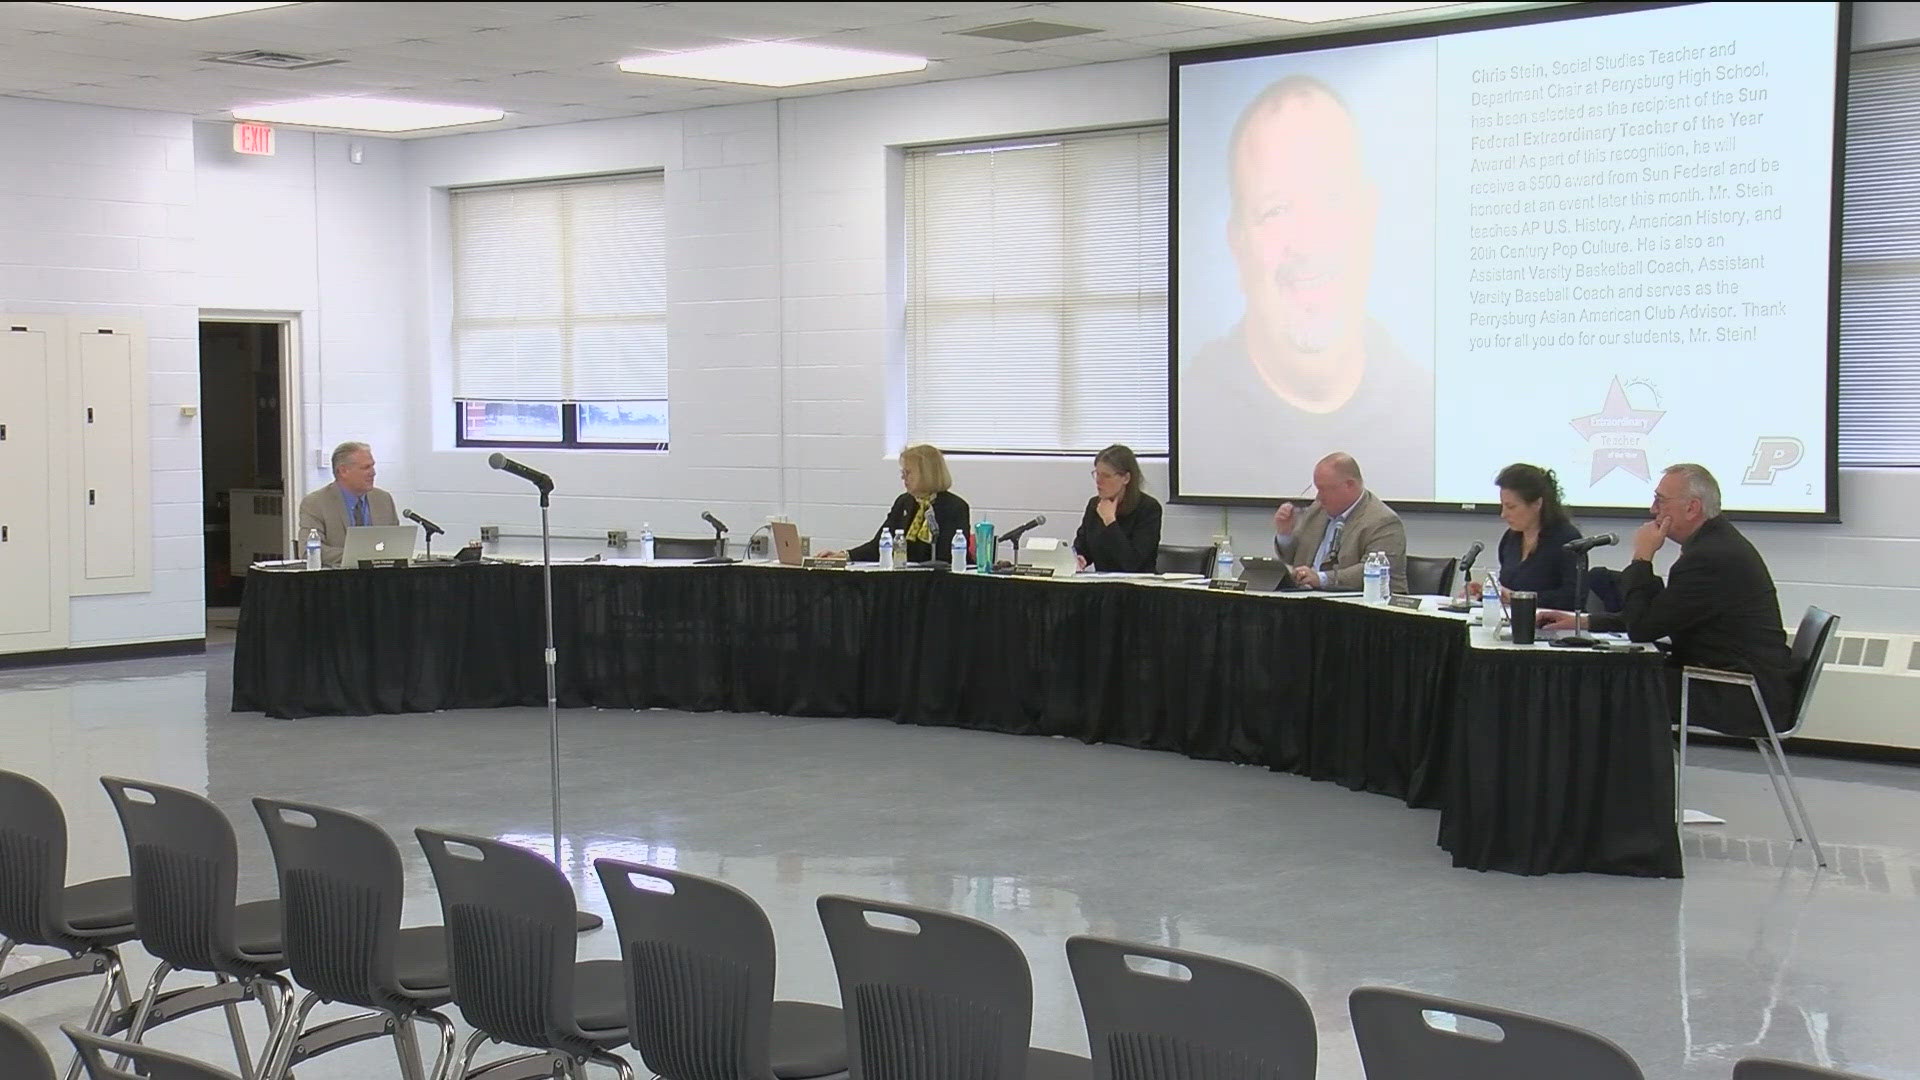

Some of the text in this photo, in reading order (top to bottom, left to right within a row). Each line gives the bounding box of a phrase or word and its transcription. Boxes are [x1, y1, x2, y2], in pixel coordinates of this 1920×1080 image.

[1472, 67, 1506, 83] Chris
[1552, 58, 1591, 76] Social
[1596, 53, 1644, 70] Studies
[1650, 47, 1705, 65] Teacher
[1709, 41, 1736, 58] and
[1472, 89, 1544, 108] Department
[1548, 83, 1582, 99] Chair
[1586, 82, 1598, 95] at
[1602, 73, 1674, 95] Perrysburg
[1678, 68, 1711, 86] High
[1471, 88, 1768, 128] has been selected as the recipient of the Sun
[241, 126, 271, 153] EXIT
[1471, 111, 1764, 150] Federal Extraordinary Teacher of the Year
[1519, 155, 1535, 168] As
[1540, 151, 1564, 169] part
[1568, 149, 1580, 164] of
[1584, 148, 1606, 163] this
[1693, 139, 1710, 154] he
[1714, 136, 1736, 153] will
[1470, 159, 1780, 194] receive a $500 award from Sun Federal and be
[1471, 202, 1520, 217] honored
[1524, 201, 1536, 213] at
[1540, 200, 1555, 212] an
[1559, 195, 1594, 211] event
[1598, 193, 1627, 209] later
[1631, 191, 1655, 206] this
[1736, 182, 1773, 198] Stein
[1470, 225, 1517, 239] teaches
[1522, 222, 1540, 236] AP
[1629, 213, 1692, 230] American
[1755, 205, 1782, 221] and
[1470, 246, 1496, 260] 20th
[1500, 242, 1548, 261] Century
[1552, 242, 1577, 259] Pop
[1637, 238, 1655, 251] He
[1660, 237, 1670, 250] is
[1675, 235, 1702, 249] also
[1707, 234, 1724, 247] an
[1470, 268, 1525, 283] Assistant
[1529, 264, 1572, 283] Varsity
[1576, 259, 1643, 278] Basketball
[1699, 254, 1765, 271] Assistant
[1470, 279, 1738, 306] Varsity Baseball Coach and serves as the
[1470, 310, 1536, 329] Perrysburg
[1540, 309, 1575, 325] Asian
[1580, 307, 1641, 323] American
[1644, 305, 1675, 321] Club
[1742, 301, 1786, 318] Thank
[1469, 336, 1490, 352] you
[1495, 332, 1511, 348] for
[1515, 332, 1529, 347] all
[1532, 333, 1555, 350] you
[1559, 331, 1575, 347] do
[1578, 330, 1595, 346] for
[1599, 332, 1620, 345] our
[1601, 436, 1640, 445] Teacher
[1741, 436, 1804, 485] P
[1806, 484, 1811, 495] 2
